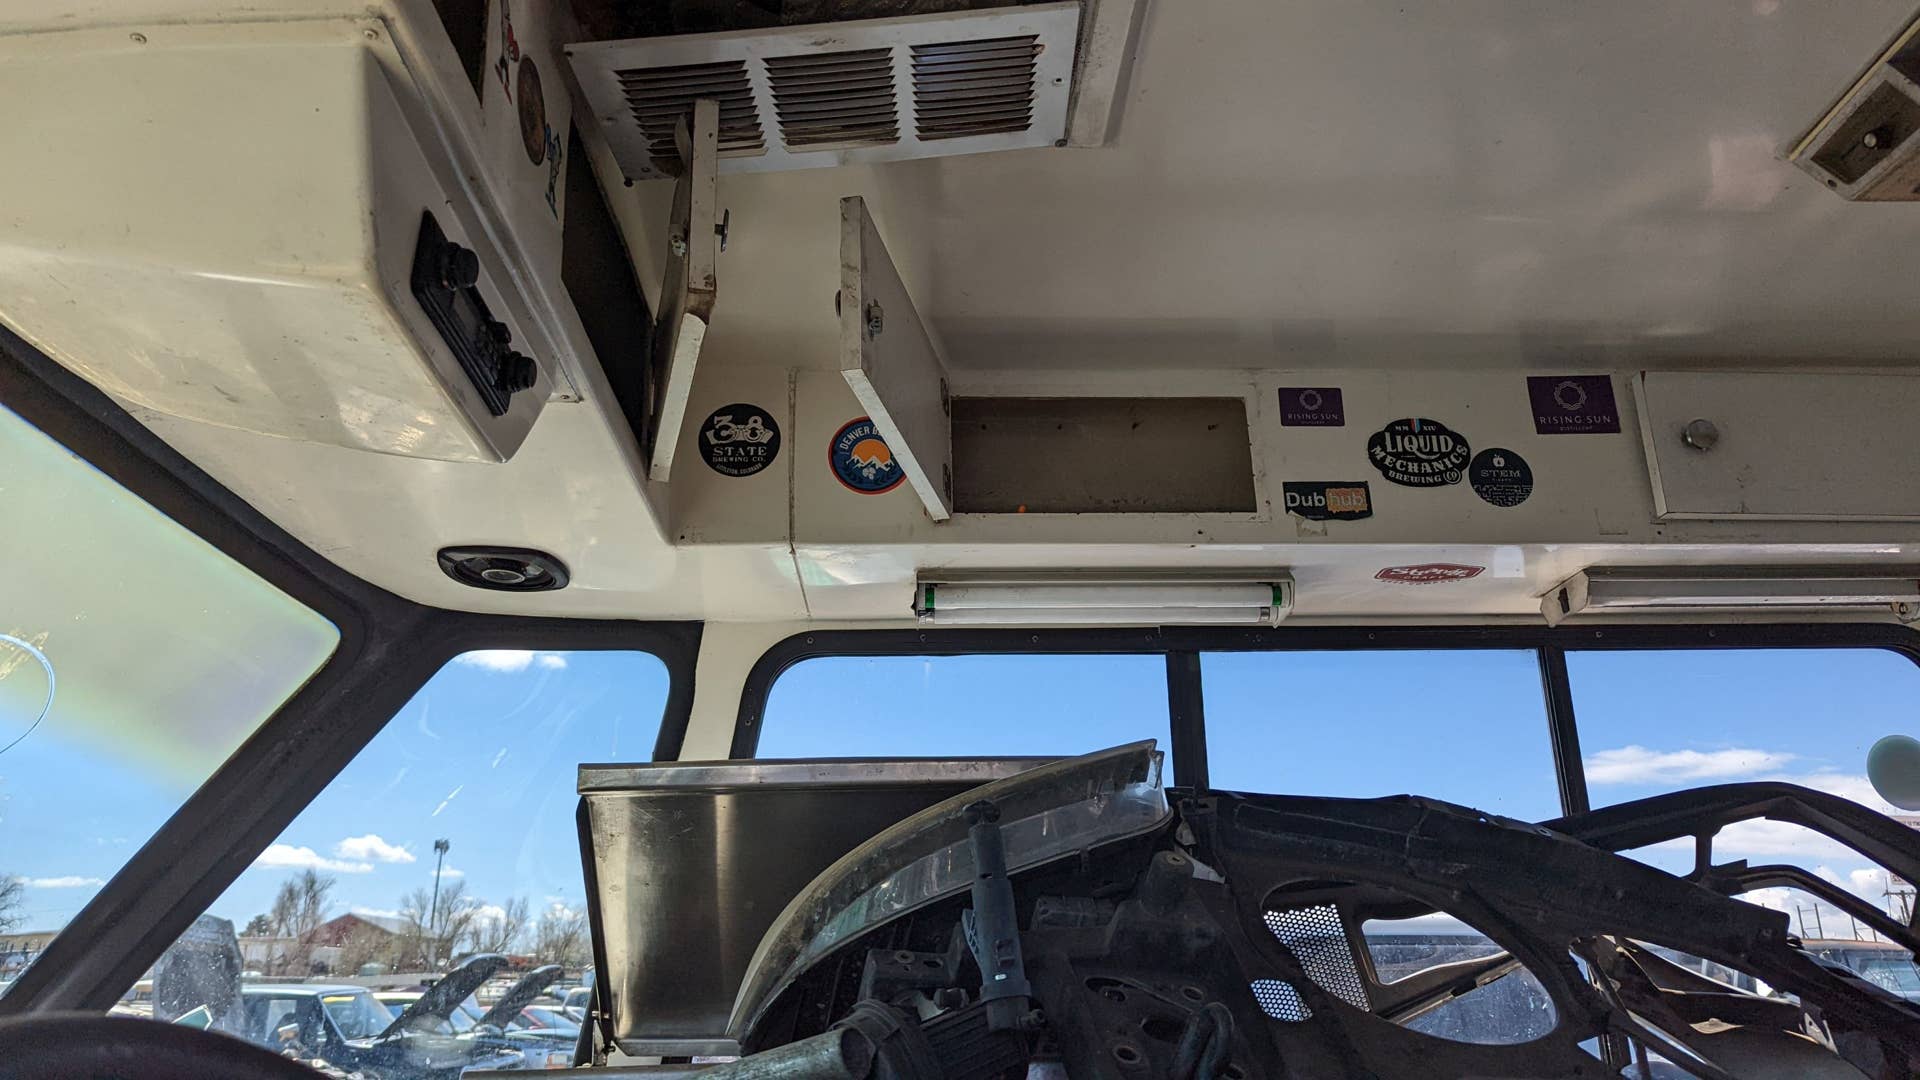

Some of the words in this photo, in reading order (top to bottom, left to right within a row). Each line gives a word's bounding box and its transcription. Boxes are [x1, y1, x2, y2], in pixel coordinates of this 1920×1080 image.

[1539, 415, 1582, 425] RISING
[1586, 415, 1611, 424] SUN
[839, 425, 870, 450] DENVER
[713, 446, 767, 456] STATE
[1384, 432, 1454, 460] LIQUID
[1371, 444, 1468, 473] MECHANICS
[1388, 470, 1442, 484] BREWING
[1480, 469, 1521, 478] STEM
